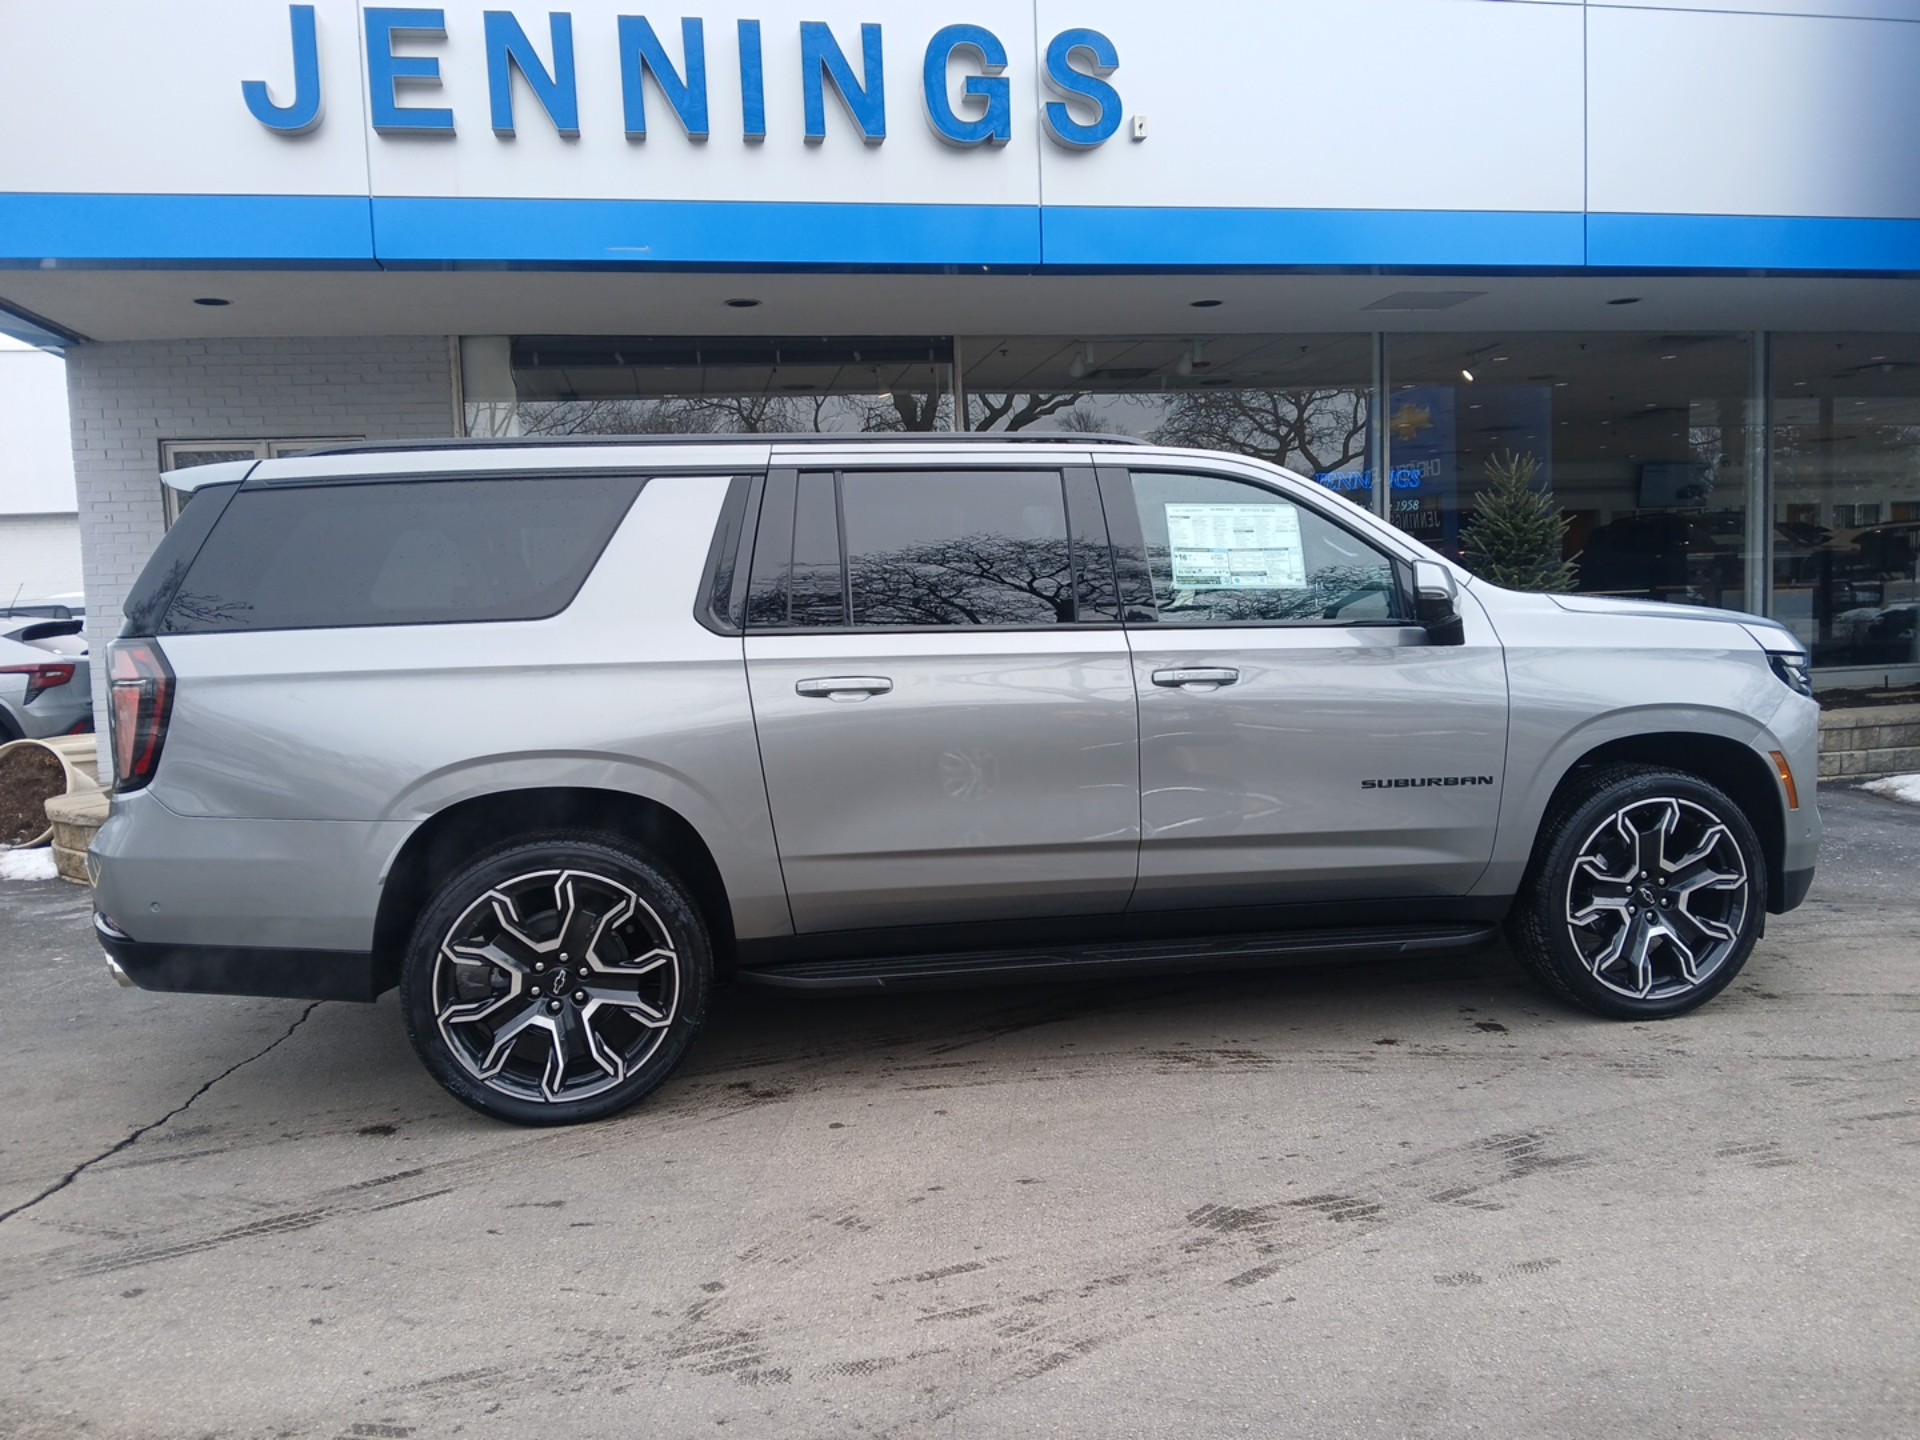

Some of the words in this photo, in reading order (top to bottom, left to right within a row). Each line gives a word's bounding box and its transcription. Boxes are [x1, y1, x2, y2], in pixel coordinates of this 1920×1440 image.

[240, 4, 1123, 151] JENNINGS
[1316, 469, 1421, 491] JENNGS
[1395, 500, 1420, 512] 1958
[1361, 775, 1494, 789] SUBURBAN
